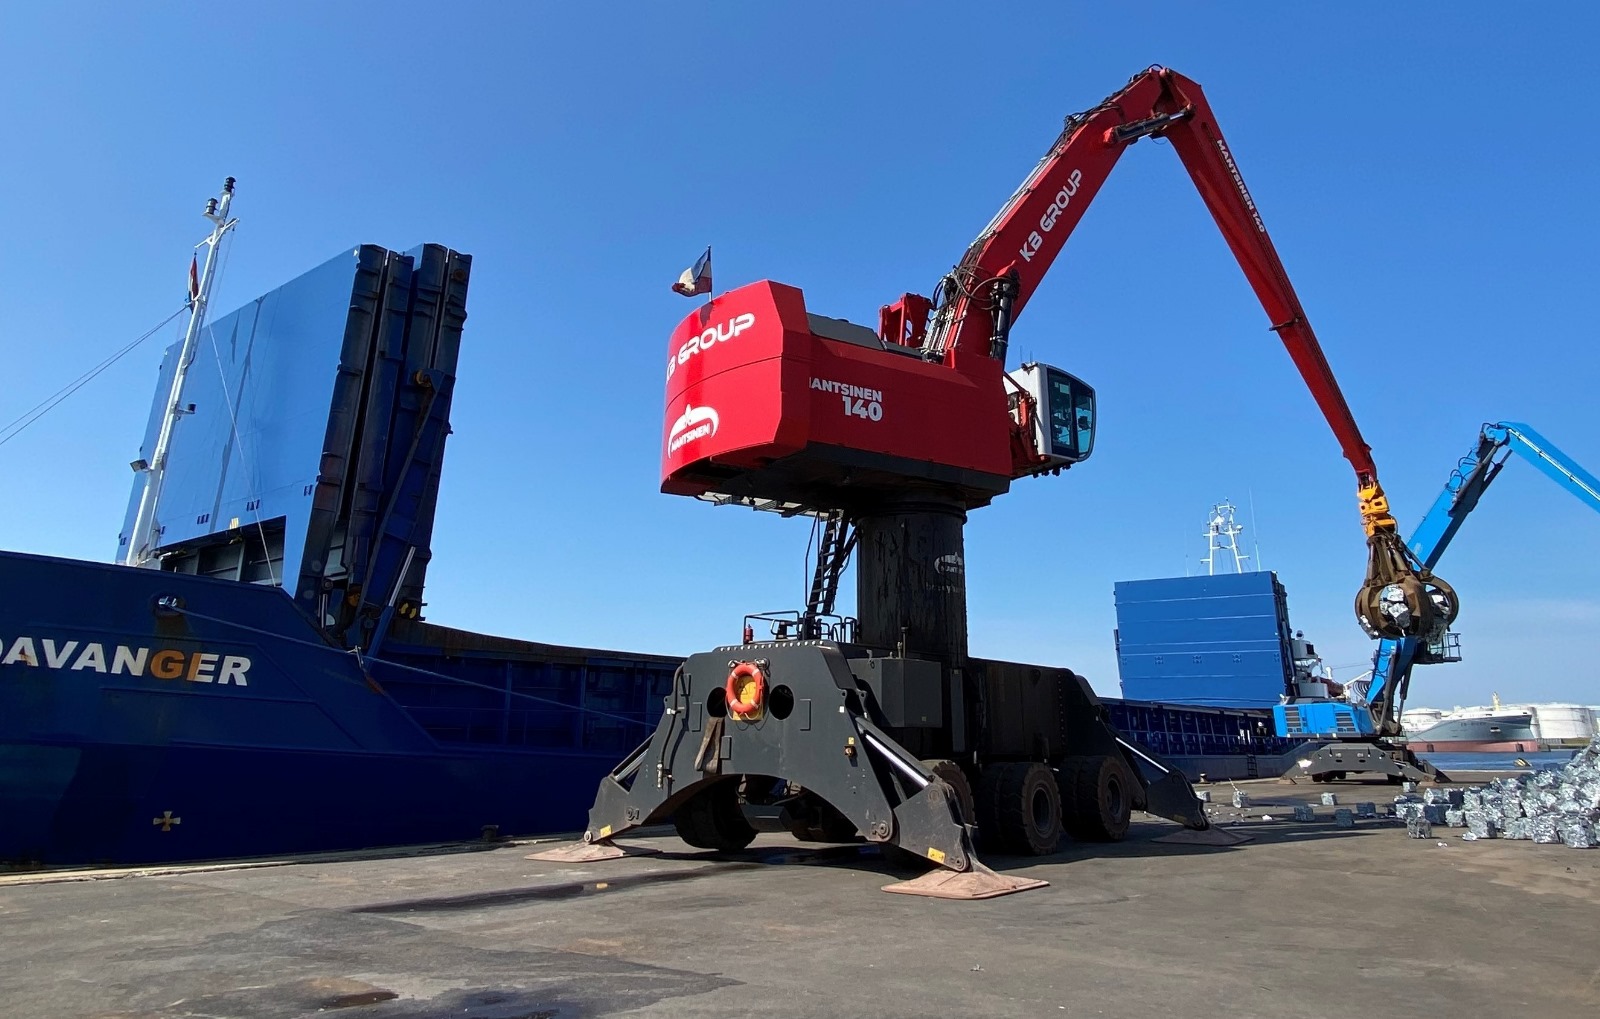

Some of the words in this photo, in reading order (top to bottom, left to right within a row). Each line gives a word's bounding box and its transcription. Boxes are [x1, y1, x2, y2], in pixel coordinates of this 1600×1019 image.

[1217, 139, 1254, 210] MANTSINEN
[1252, 211, 1265, 232] 140
[1019, 230, 1043, 262] KB
[1040, 168, 1082, 232] GROUP
[677, 312, 755, 365] GROUP
[808, 376, 882, 402] ANTSINEN
[842, 395, 883, 422] 140
[0, 636, 251, 686] AVANGER
